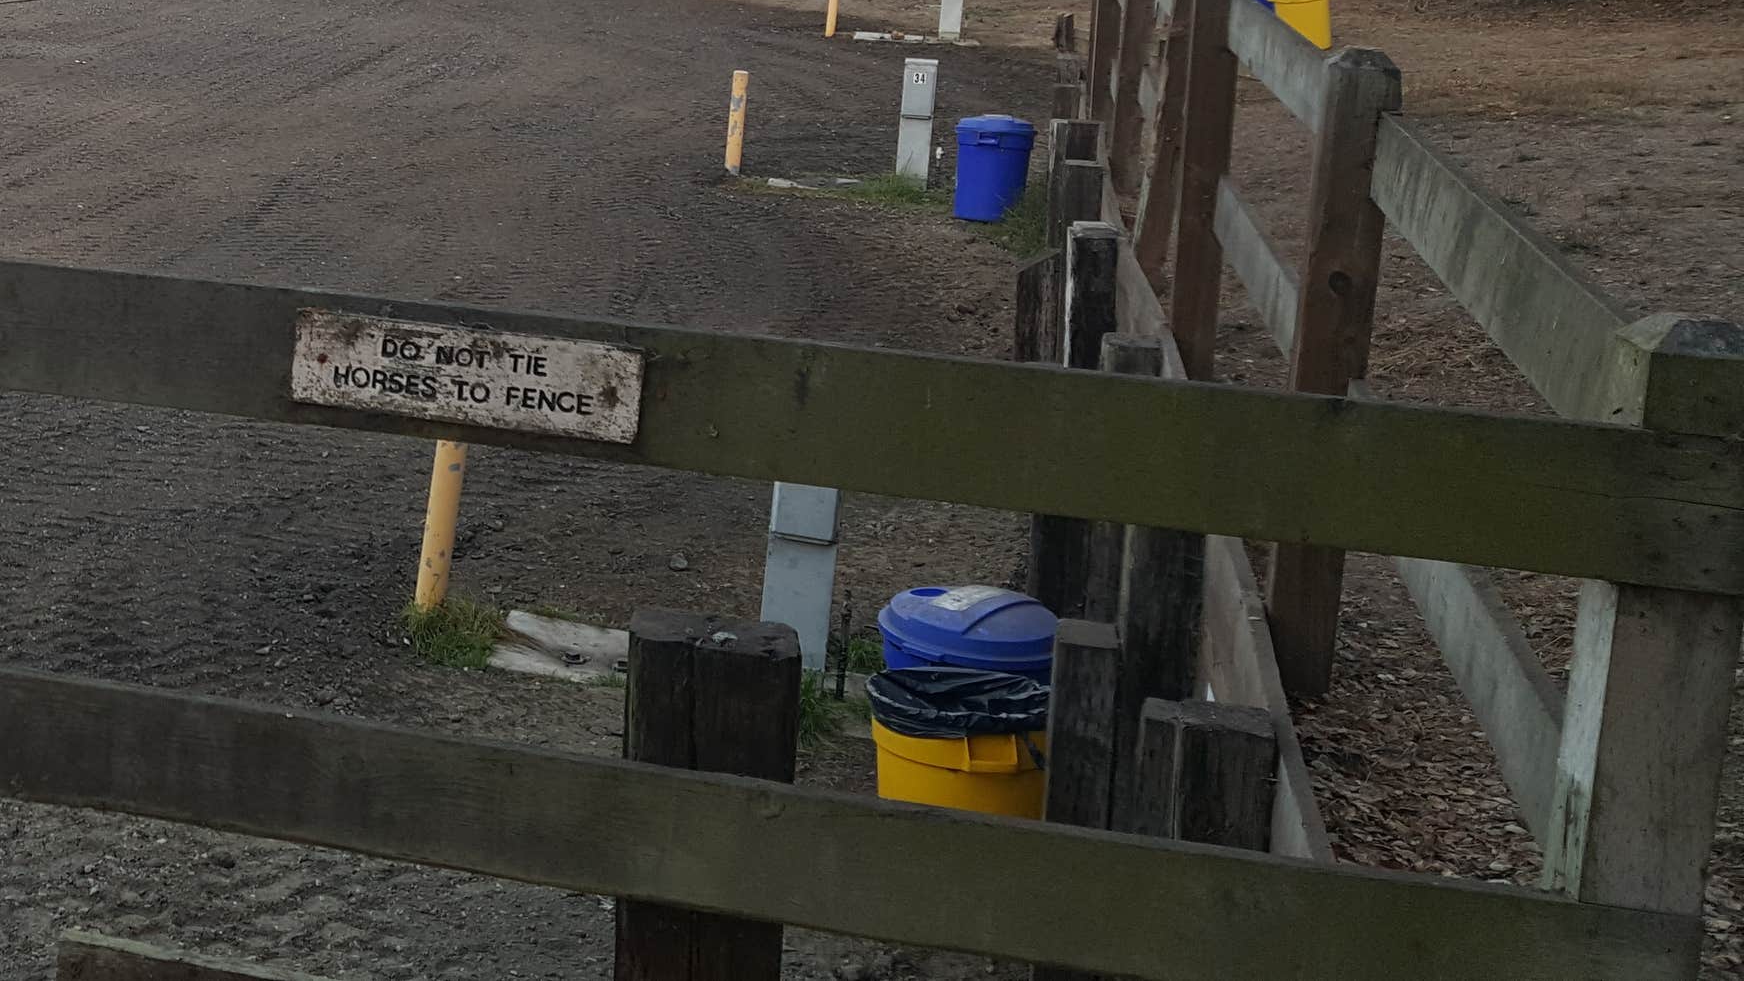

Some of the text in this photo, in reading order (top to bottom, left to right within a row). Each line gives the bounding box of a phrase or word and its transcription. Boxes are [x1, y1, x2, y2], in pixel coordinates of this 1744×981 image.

[381, 338, 548, 377] DO NOT TIE
[333, 365, 594, 415] HORSES TO FENCE
